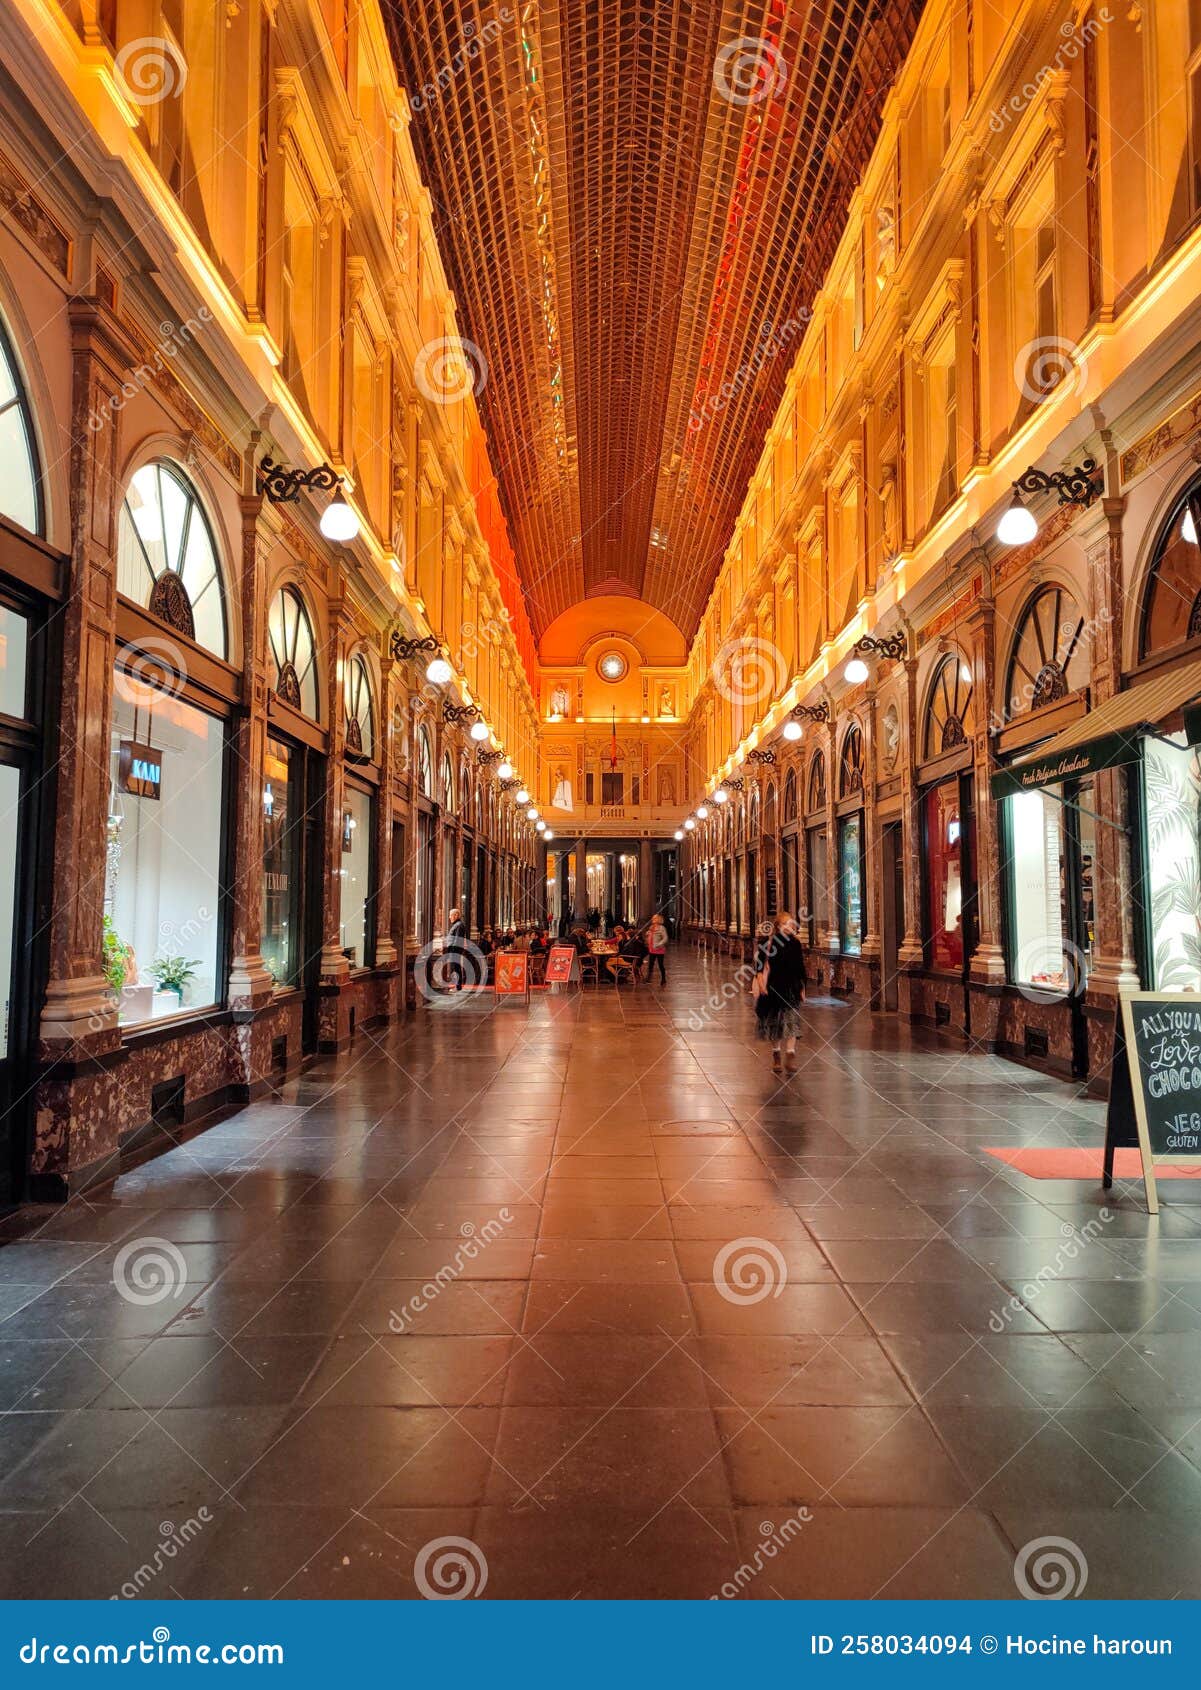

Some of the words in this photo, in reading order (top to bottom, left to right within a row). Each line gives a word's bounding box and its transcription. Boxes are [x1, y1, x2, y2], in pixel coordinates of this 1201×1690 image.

[1035, 764, 1057, 785] Belgian
[1150, 1036, 1200, 1069] Love
[1166, 1135, 1198, 1148] GLUTEN
